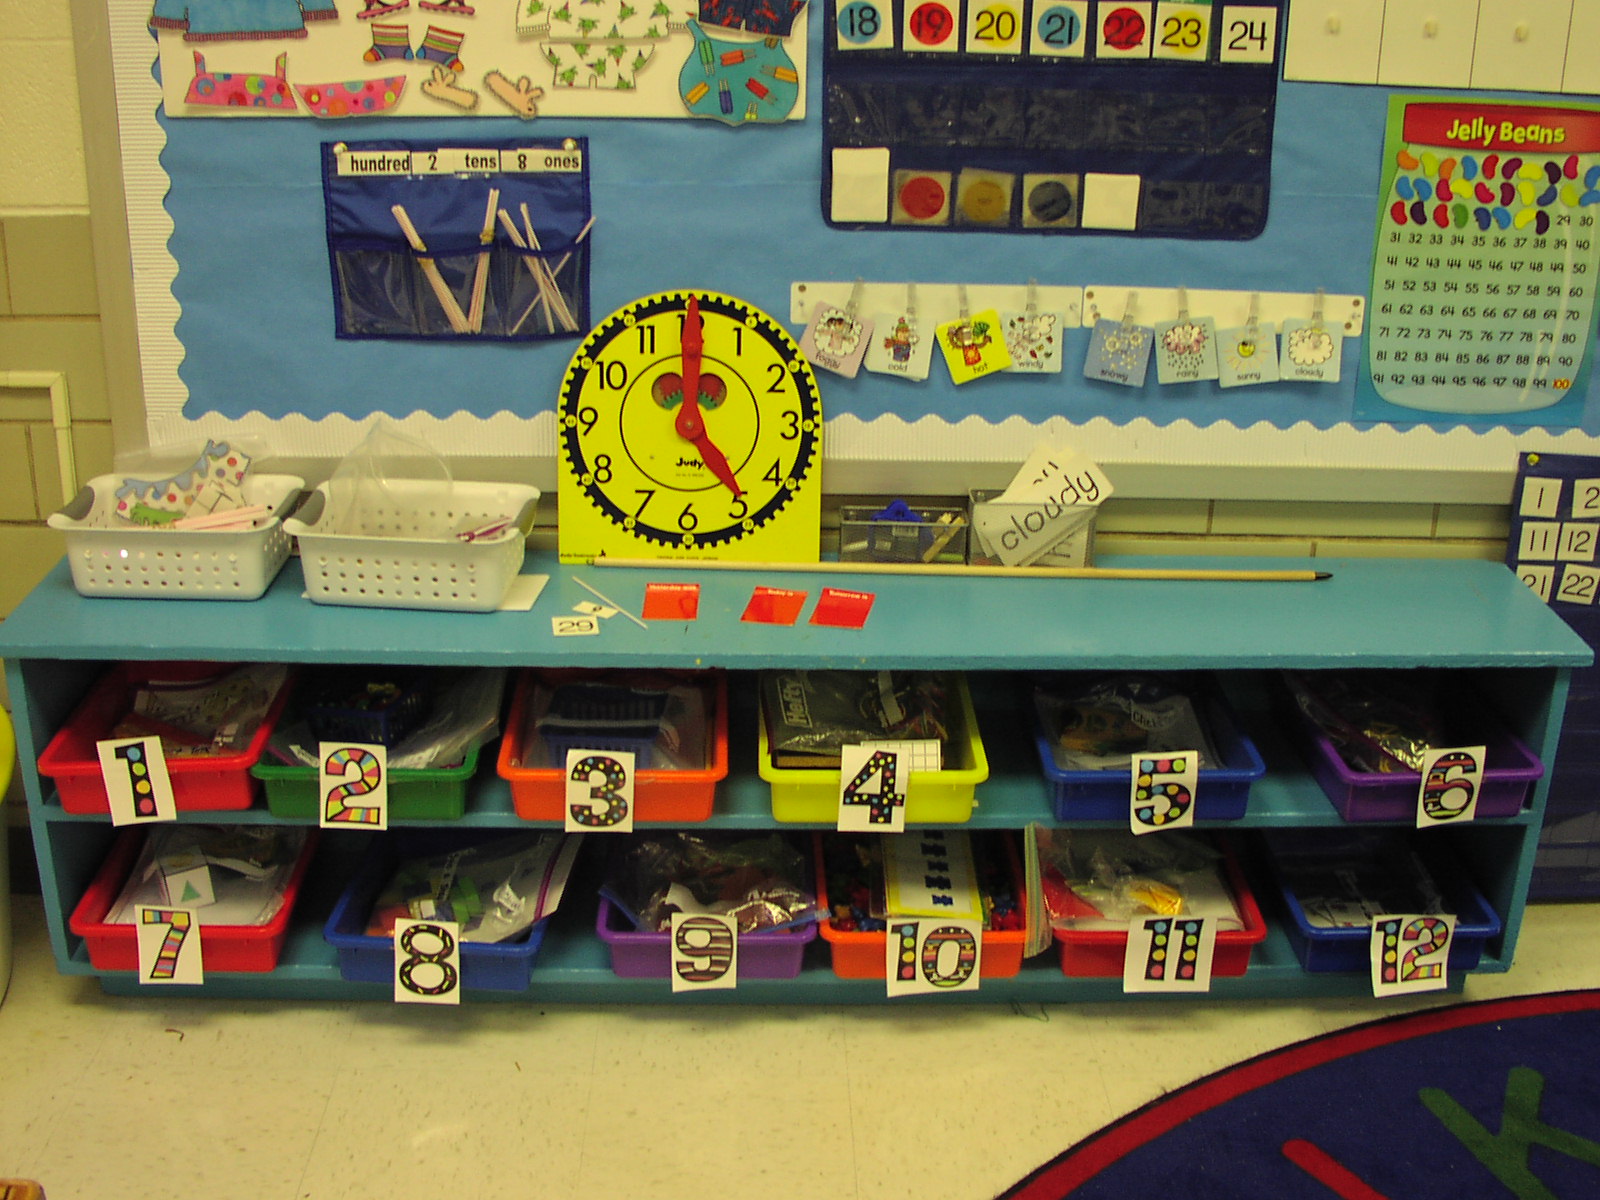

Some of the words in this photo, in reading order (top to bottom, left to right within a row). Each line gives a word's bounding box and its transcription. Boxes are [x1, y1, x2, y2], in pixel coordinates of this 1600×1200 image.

[848, 5, 880, 37] 18
[916, 8, 946, 39] 19
[974, 9, 1016, 41] 20
[1044, 13, 1075, 45] 21
[1103, 15, 1144, 46] 22
[1160, 17, 1202, 48] 23
[1227, 20, 1268, 52] 24
[1446, 116, 1496, 147] Jelly
[1499, 120, 1566, 145] Beans
[350, 154, 411, 173] hundred
[427, 154, 438, 172] 2
[464, 153, 497, 170] tens
[517, 154, 527, 170] 8
[544, 154, 579, 169] ones
[1556, 214, 1571, 226] 29
[1579, 215, 1594, 227] 30
[1389, 231, 1401, 243] 31
[1408, 232, 1423, 245] 32
[1429, 233, 1444, 245] 33
[1450, 234, 1465, 246] 34
[1471, 235, 1486, 247] 35
[1492, 236, 1507, 248] 36
[1513, 237, 1528, 248] 37
[1533, 237, 1547, 249] 38
[1553, 238, 1568, 250] 39
[1575, 239, 1591, 251] 40
[1386, 255, 1398, 267] 41
[1405, 256, 1420, 268] 42
[1425, 257, 1440, 269] 43
[1446, 258, 1462, 269] 44
[1468, 259, 1483, 271] 45
[1488, 260, 1503, 271] 46
[1510, 260, 1525, 272] 47
[1529, 261, 1544, 273] 48
[1549, 262, 1565, 273] 49
[1572, 262, 1587, 275] 50
[1383, 279, 1396, 291] 51
[1402, 279, 1417, 292] 52
[1423, 280, 1437, 292] 53
[1443, 281, 1458, 293] 54
[1464, 282, 1480, 294] 55
[1486, 283, 1500, 295] 56
[1506, 284, 1521, 296] 57
[1526, 284, 1541, 297] 58
[1546, 285, 1561, 297] 59
[1568, 286, 1584, 298] 60
[1381, 303, 1393, 314] 61
[1398, 303, 1414, 315] 62
[1419, 304, 1434, 316] 63
[1440, 305, 1455, 317] 64
[1461, 306, 1477, 318] 65
[1482, 307, 1497, 318] 66
[1502, 307, 1518, 319] 67
[1522, 308, 1537, 320] 68
[1543, 309, 1558, 320] 69
[1565, 309, 1581, 321] 70
[636, 324, 656, 355] 11
[678, 313, 705, 343] 1
[732, 326, 743, 357] 1
[1379, 326, 1390, 338] 71
[1396, 326, 1411, 339] 72
[1417, 327, 1431, 339] 73
[1437, 328, 1452, 340] 74
[1459, 329, 1474, 341] 75
[1480, 330, 1494, 342] 76
[1499, 330, 1514, 342] 77
[1519, 331, 1534, 343] 78
[1539, 331, 1554, 344] 79
[1561, 333, 1577, 344] 80
[815, 351, 840, 370] foggy
[887, 362, 908, 372] cold
[972, 362, 989, 374] hot
[1018, 358, 1044, 370] windy
[1176, 368, 1199, 378] rainy
[1294, 367, 1324, 379] cloudy
[1376, 350, 1388, 362] 81
[1393, 350, 1409, 362] 82
[1414, 351, 1429, 363] 83
[1434, 352, 1449, 363] 84
[1455, 352, 1470, 365] 85
[1475, 354, 1490, 364] 86
[1495, 354, 1511, 365] 87
[1515, 354, 1530, 366] 88
[1536, 354, 1551, 367] 89
[1558, 356, 1574, 367] 90
[596, 360, 628, 391] 10
[766, 363, 786, 393] 2
[1099, 368, 1129, 382] snowy
[1236, 371, 1261, 382] sunny
[1373, 373, 1385, 384] 91
[1390, 374, 1406, 385] 92
[1410, 374, 1426, 386] 93
[1431, 375, 1446, 386] 94
[1451, 375, 1467, 387] 95
[1472, 376, 1487, 387] 96
[1492, 376, 1508, 387] 97
[1511, 377, 1527, 389] 98
[1532, 378, 1548, 389] 99
[1552, 378, 1570, 390] 100
[578, 406, 599, 437] 9
[780, 410, 800, 440] 3
[593, 454, 613, 484] 8
[675, 457, 704, 470] Judy
[762, 457, 784, 487] 4
[634, 489, 656, 519] 7
[728, 490, 748, 519] 5
[1001, 470, 1100, 551] cloudy
[1537, 486, 1545, 510] 1
[1583, 486, 1600, 510] 2
[677, 503, 698, 532] 6
[1529, 529, 1549, 552] 11
[1567, 530, 1591, 553] 12
[1562, 573, 1595, 598] 22
[558, 620, 594, 633] 29
[114, 741, 158, 818] 1
[325, 747, 381, 825] 2
[570, 755, 629, 828] 3
[842, 750, 905, 824] 4
[1135, 757, 1192, 827] 5
[1421, 752, 1478, 821] 6
[141, 908, 192, 979] 7
[675, 916, 735, 983] 9
[890, 921, 978, 988] 10
[1143, 918, 1205, 981] 11
[1376, 917, 1450, 985] 12
[399, 923, 458, 996] 8
